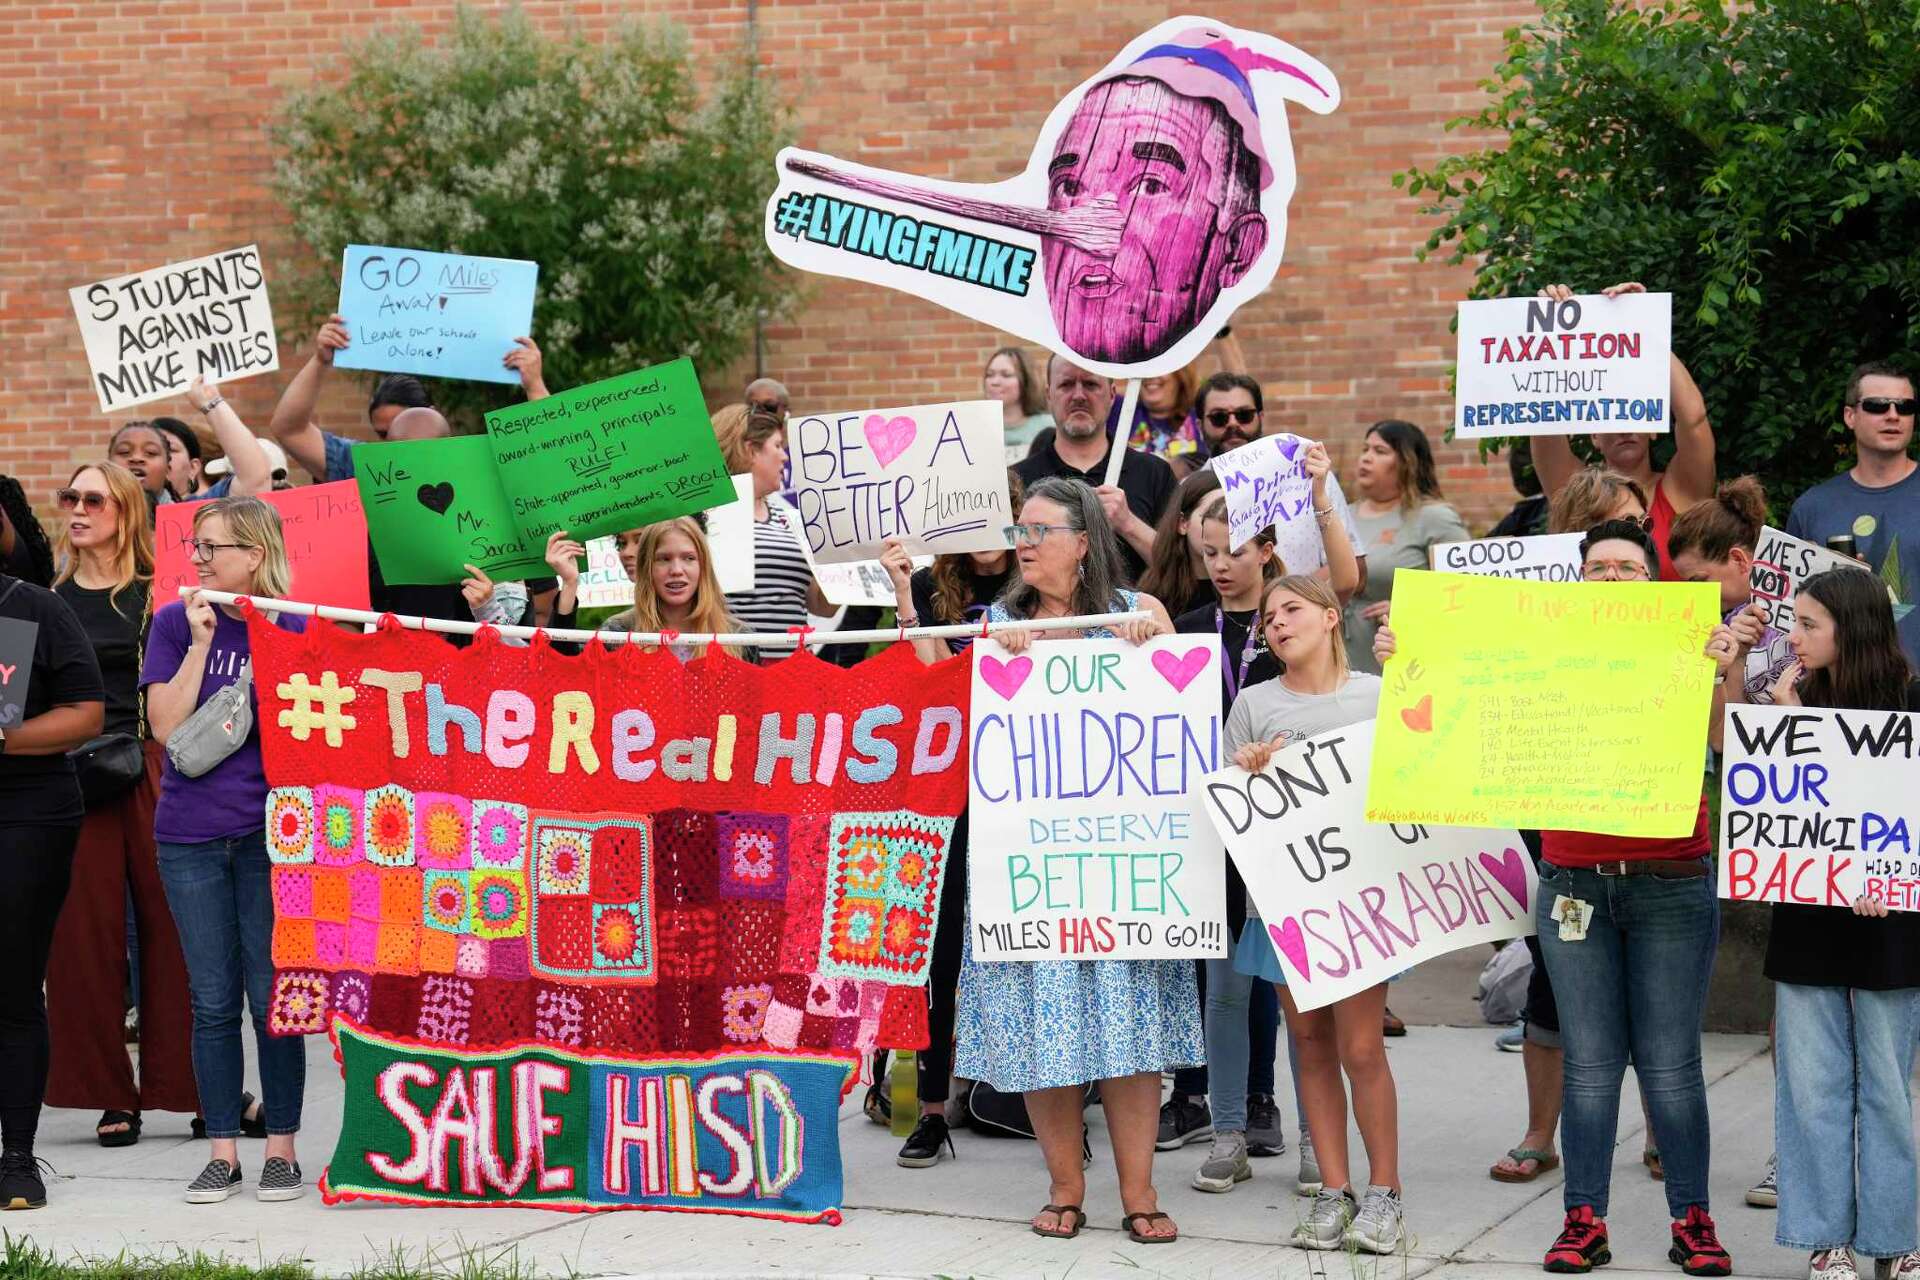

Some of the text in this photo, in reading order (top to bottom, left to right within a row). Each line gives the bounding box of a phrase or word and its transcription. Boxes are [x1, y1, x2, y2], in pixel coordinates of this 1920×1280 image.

[774, 191, 1036, 297] #LYINGFMIKE
[87, 252, 263, 322] STUDENTS
[360, 256, 500, 292] GO Miles
[119, 295, 251, 360] AGAINST
[360, 321, 480, 345] Leave our schools
[1526, 299, 1582, 333] NO
[98, 330, 273, 405] MIKE MILES
[387, 343, 443, 360] alone!
[1480, 332, 1641, 364] TAXATION
[1511, 369, 1608, 394] WITHOUT
[489, 377, 667, 440] Respected, experienced,
[1463, 398, 1664, 428] REPRESENTATION
[498, 401, 676, 465] award-winning principals
[799, 410, 975, 484] BE A
[365, 460, 412, 487] We
[565, 441, 627, 473] RULE!
[456, 510, 490, 534] Mr.
[798, 475, 1002, 554] BETTER Human
[1446, 541, 1525, 569] GOOD
[1045, 653, 1127, 695] OUR
[973, 708, 1218, 803] CHILDREN
[1730, 711, 1920, 760] WE WA
[1207, 736, 1353, 835] DON'T
[1727, 762, 1831, 808] OUR
[1029, 811, 1191, 845] DESERVE
[1727, 810, 1920, 855] PRINCIPA
[1286, 826, 1352, 883] US
[1727, 848, 1852, 906] BACK
[1007, 852, 1191, 917] BETTER
[978, 916, 1221, 954] MILES HAS TO GO!!!
[1301, 855, 1515, 979] SARABIA
[603, 1067, 804, 1200] HISD
